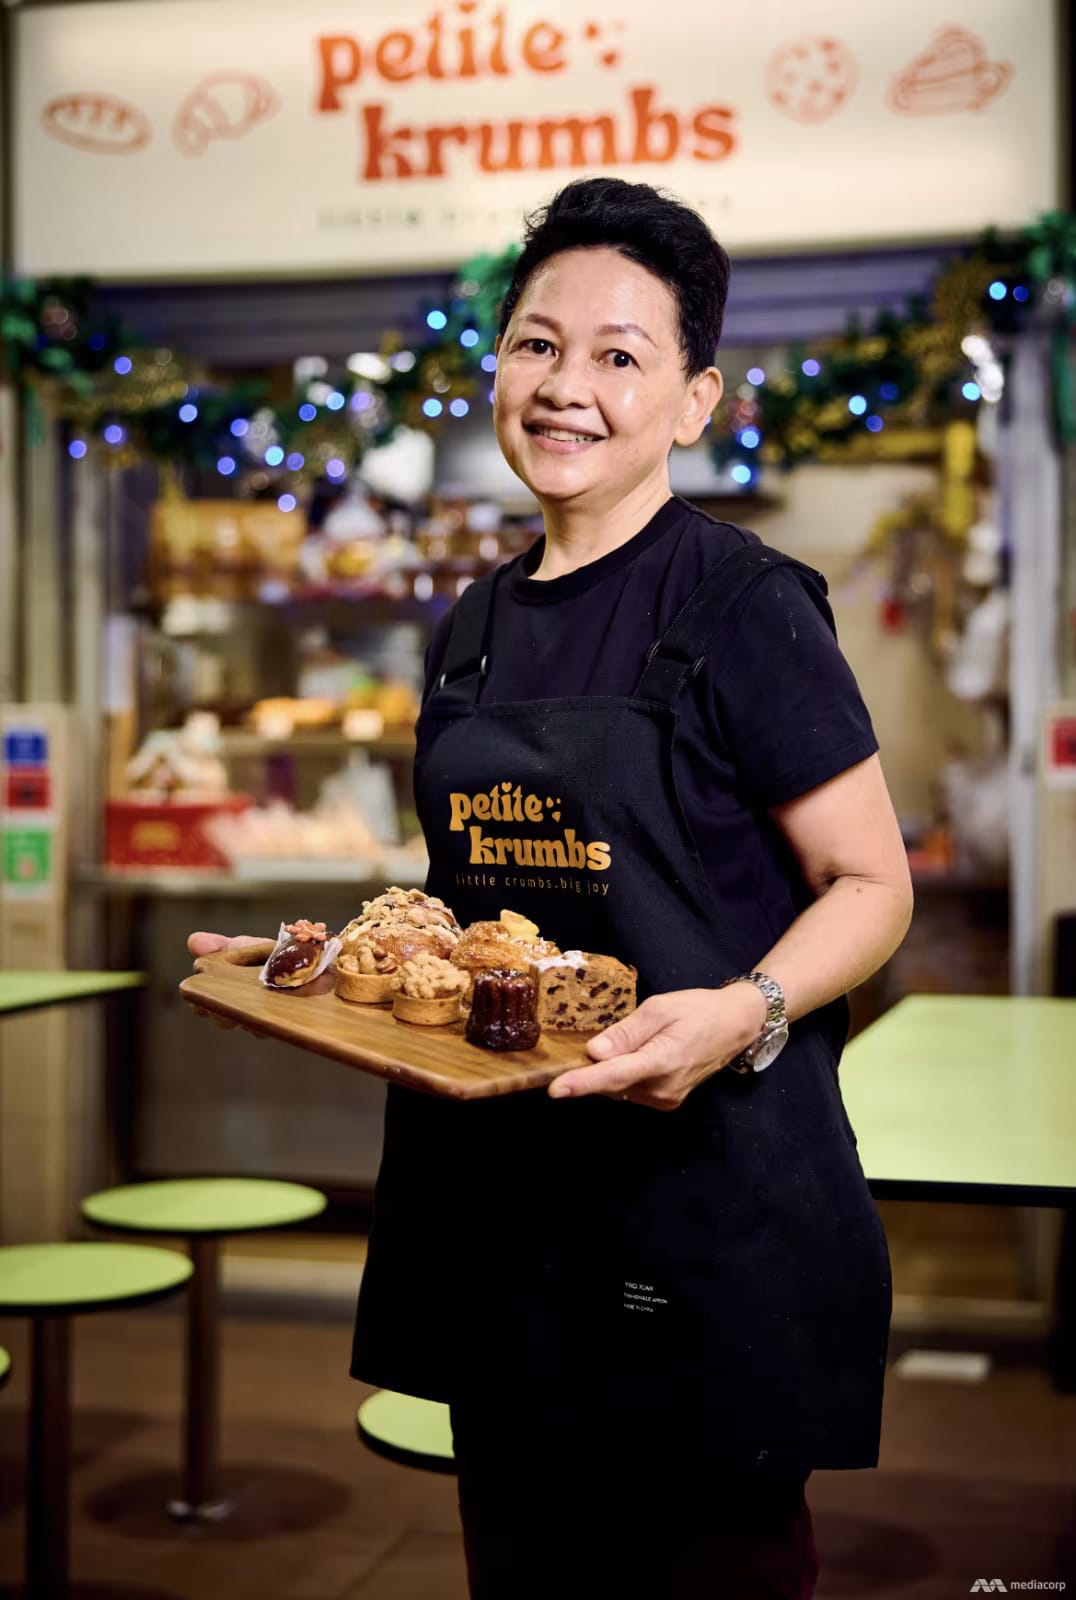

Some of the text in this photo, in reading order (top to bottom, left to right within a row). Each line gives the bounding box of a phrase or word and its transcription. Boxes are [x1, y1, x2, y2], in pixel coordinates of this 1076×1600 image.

[318, 0, 569, 112] petite
[362, 87, 738, 181] krumbs
[449, 782, 544, 831] petite
[469, 825, 612, 871] krumbs
[456, 872, 496, 886] little
[587, 880, 609, 896] joy
